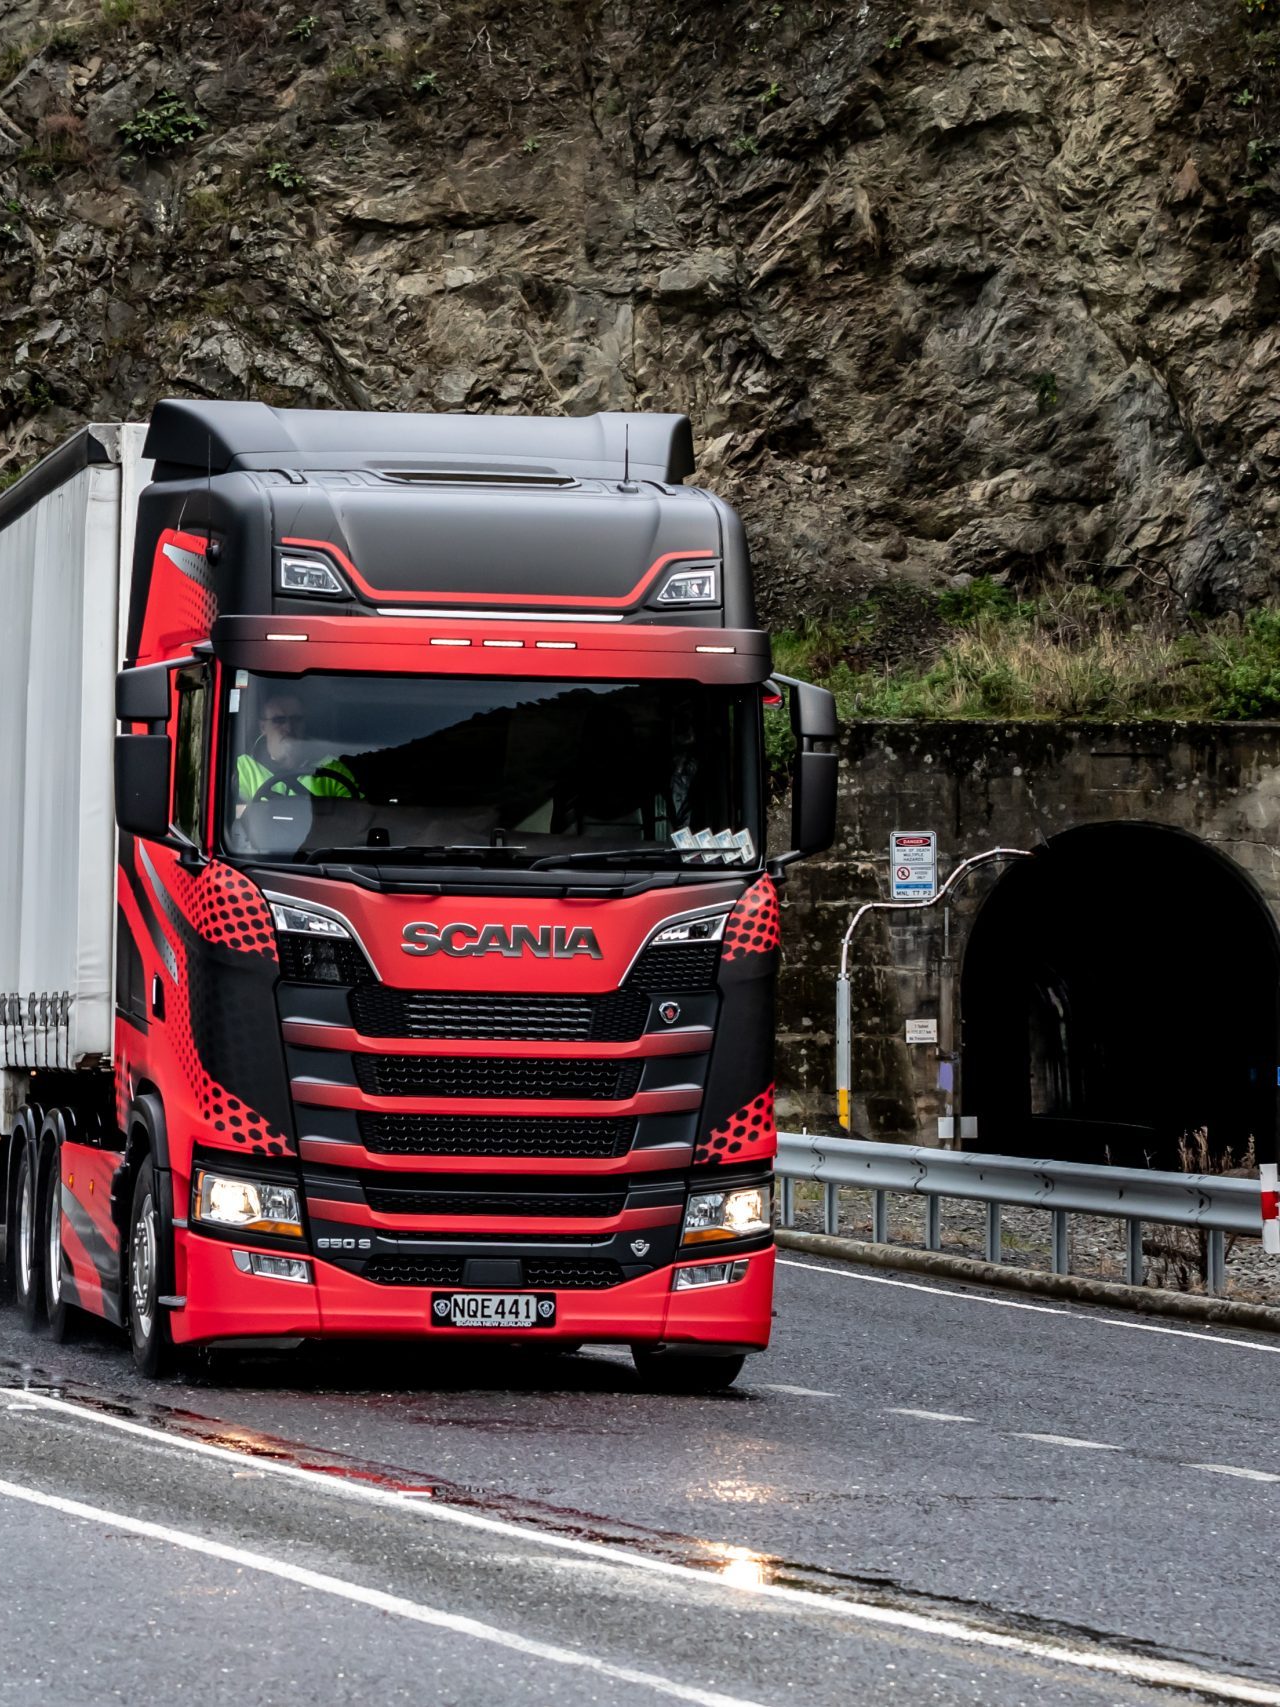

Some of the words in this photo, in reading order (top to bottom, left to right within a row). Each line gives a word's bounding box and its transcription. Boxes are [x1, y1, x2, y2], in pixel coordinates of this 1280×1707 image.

[400, 921, 604, 960] SCANIA
[317, 1238, 356, 1249] 650
[358, 1238, 371, 1249] S
[452, 1298, 531, 1319] NQE441
